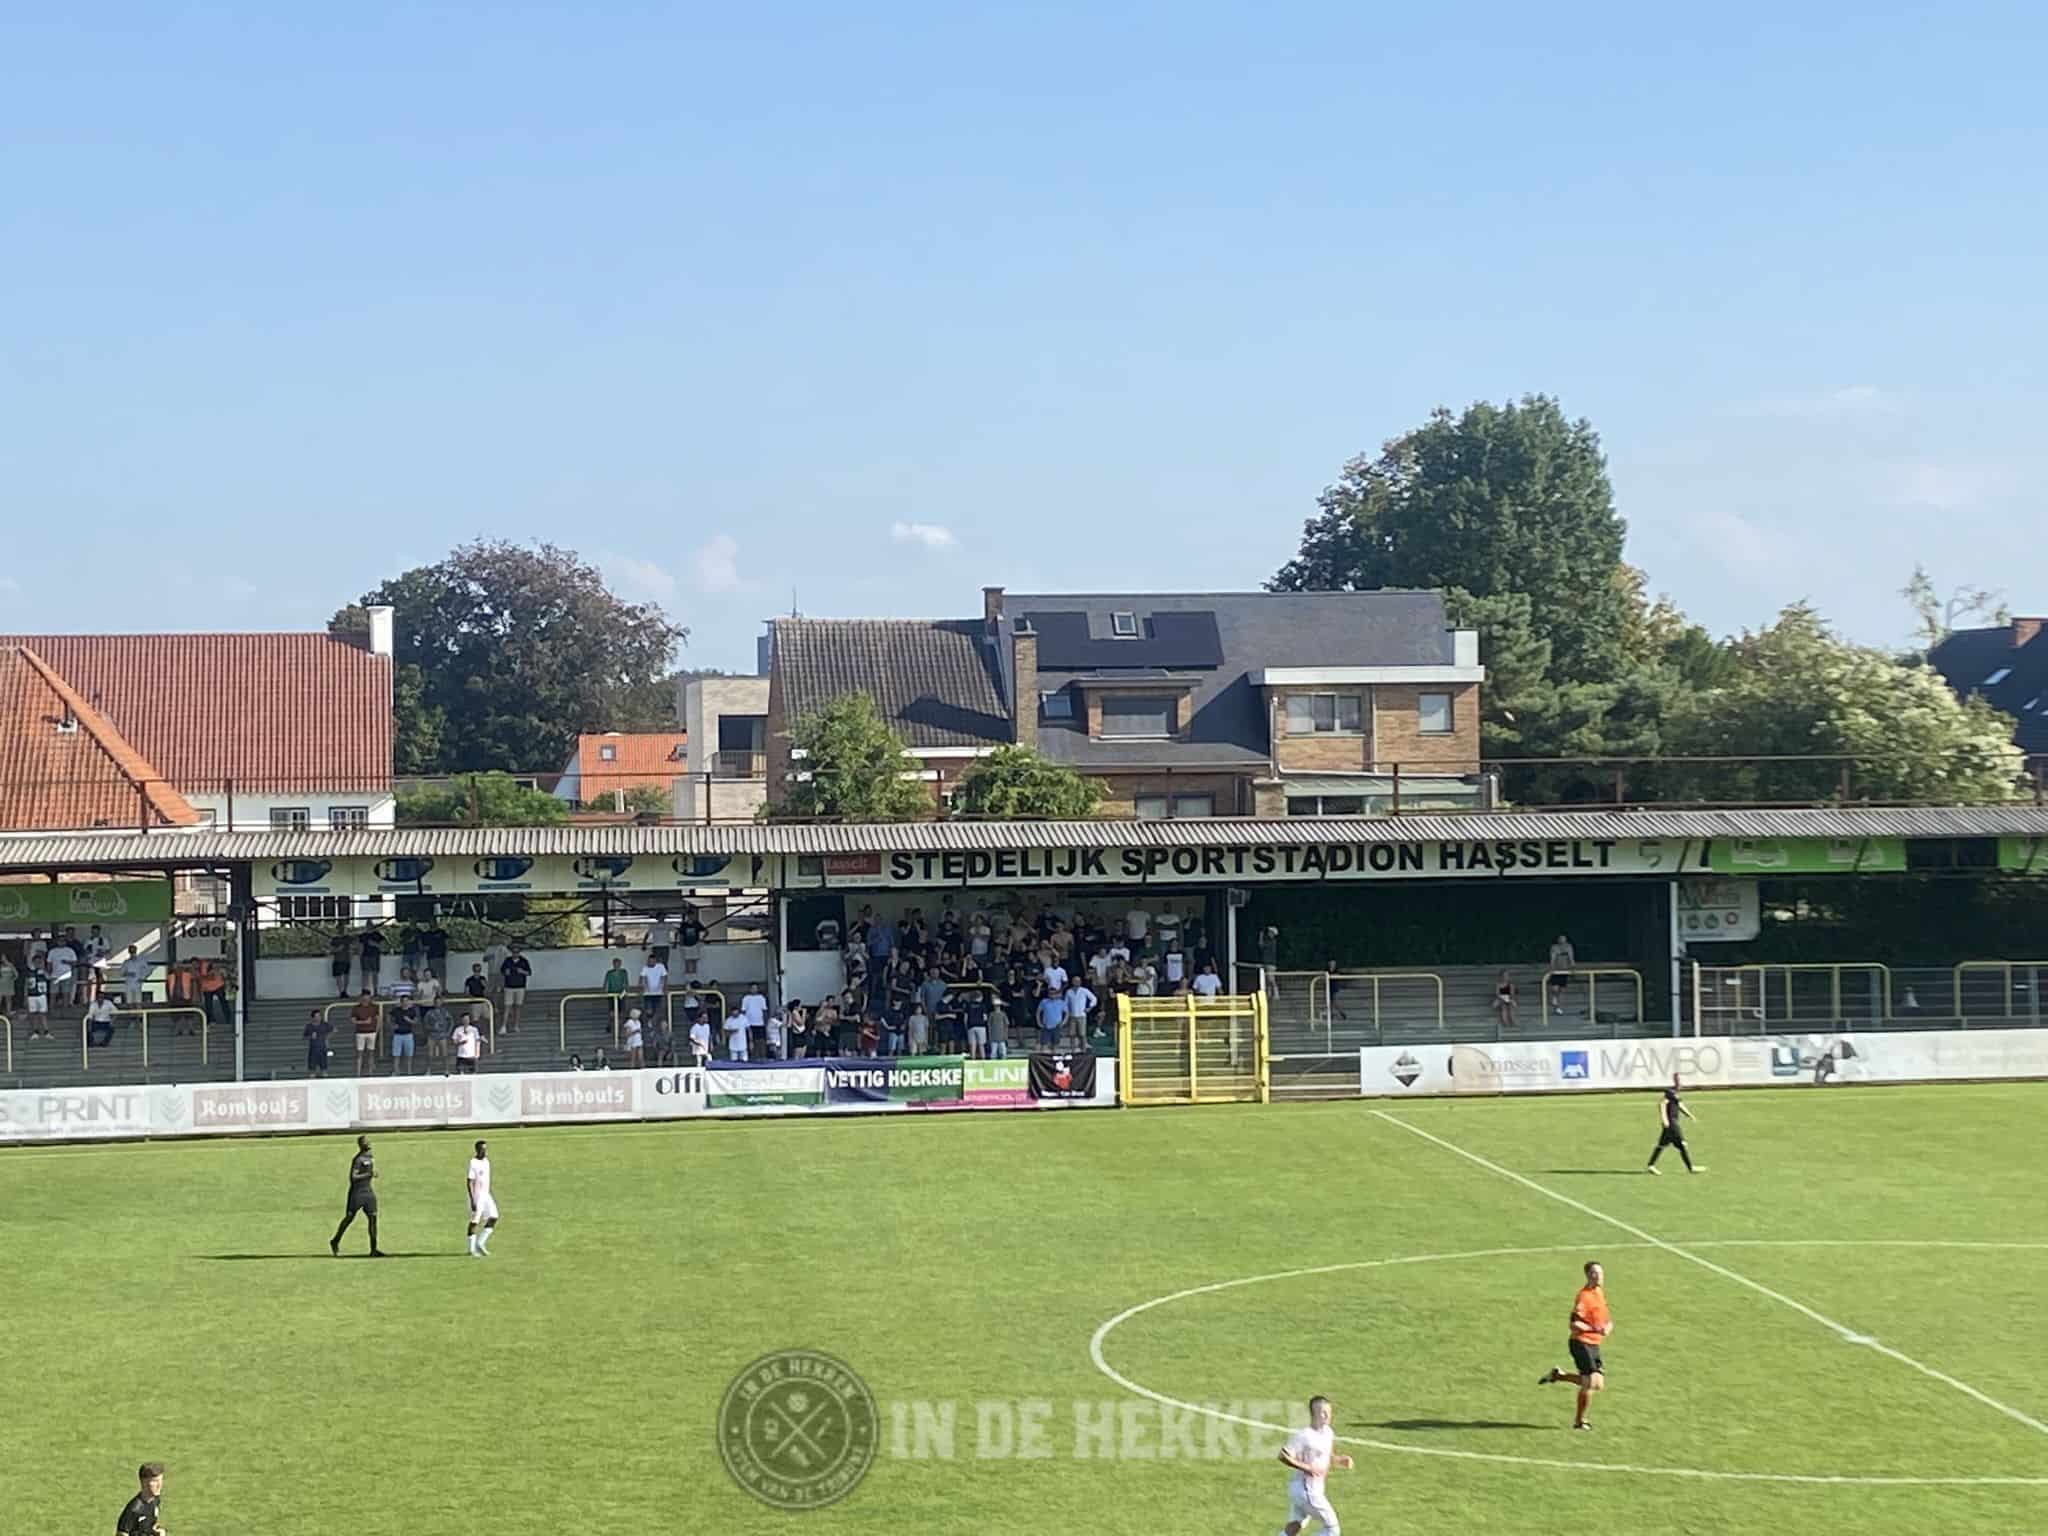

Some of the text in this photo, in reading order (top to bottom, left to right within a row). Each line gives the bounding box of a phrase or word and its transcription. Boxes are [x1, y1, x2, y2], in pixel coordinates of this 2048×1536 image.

[890, 840, 1616, 881] STEDELIJK SPORTSTADION HASSELT
[1601, 1045, 1723, 1079] MAMBO
[827, 1067, 962, 1089] VETTIG HOEKSKE
[37, 1093, 142, 1123] PRINT
[366, 1090, 464, 1114] Rombouts
[530, 1085, 625, 1108] Rombouts
